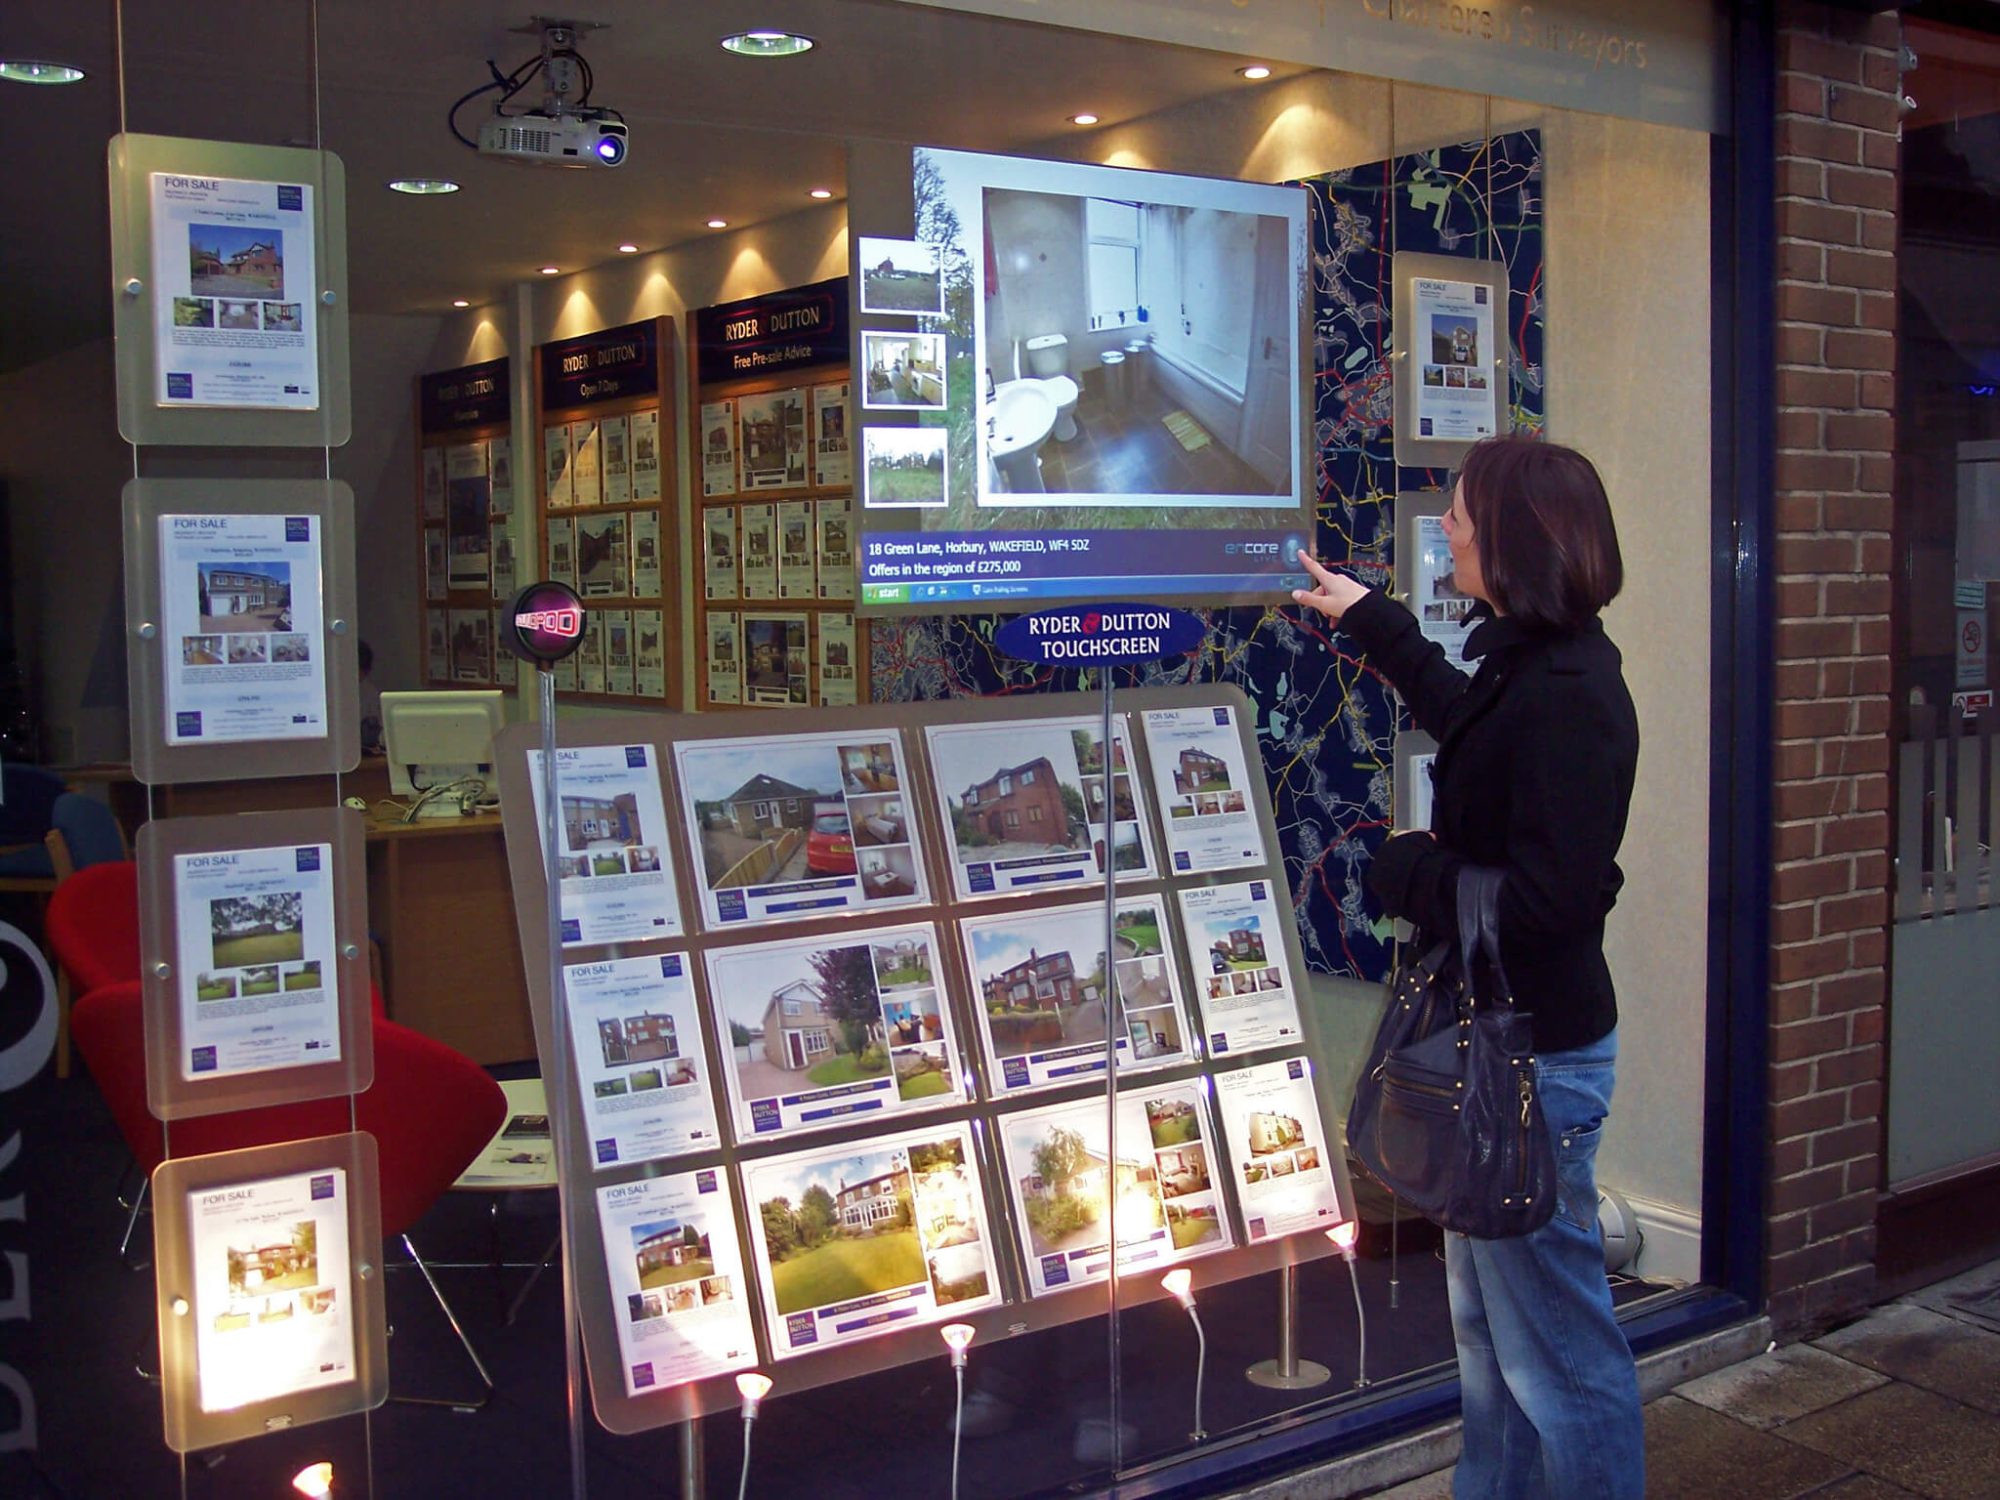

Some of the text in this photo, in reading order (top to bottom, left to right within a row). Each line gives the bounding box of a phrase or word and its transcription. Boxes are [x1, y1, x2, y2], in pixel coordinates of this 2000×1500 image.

[1519, 5, 1650, 71] Surveyors
[165, 177, 220, 192] FOR SALE
[726, 306, 820, 341] RYDER DUTTON
[563, 343, 636, 373] RYDER DUTTON
[733, 344, 812, 370] Free Pre-sale Advice
[174, 519, 227, 529] FOR SALE
[869, 543, 882, 556] 18
[884, 543, 914, 555] Green
[916, 542, 943, 556] Lane,
[945, 540, 987, 555] Horbury,
[989, 540, 1047, 554] WAKEFIELD,
[1048, 539, 1069, 551] WF4
[869, 560, 1021, 577] Offers in the region of £275,000
[879, 588, 900, 598] start
[1029, 616, 1081, 635] RYDER
[1102, 612, 1170, 632] DUTTON
[1041, 637, 1160, 659] TOUCHSCREEN
[557, 751, 579, 760] SALE
[187, 855, 239, 868] FOR SALE
[572, 965, 615, 977] FOR SALE
[203, 1189, 255, 1205] FOR SALE
[606, 1184, 649, 1199] FOR SALE
